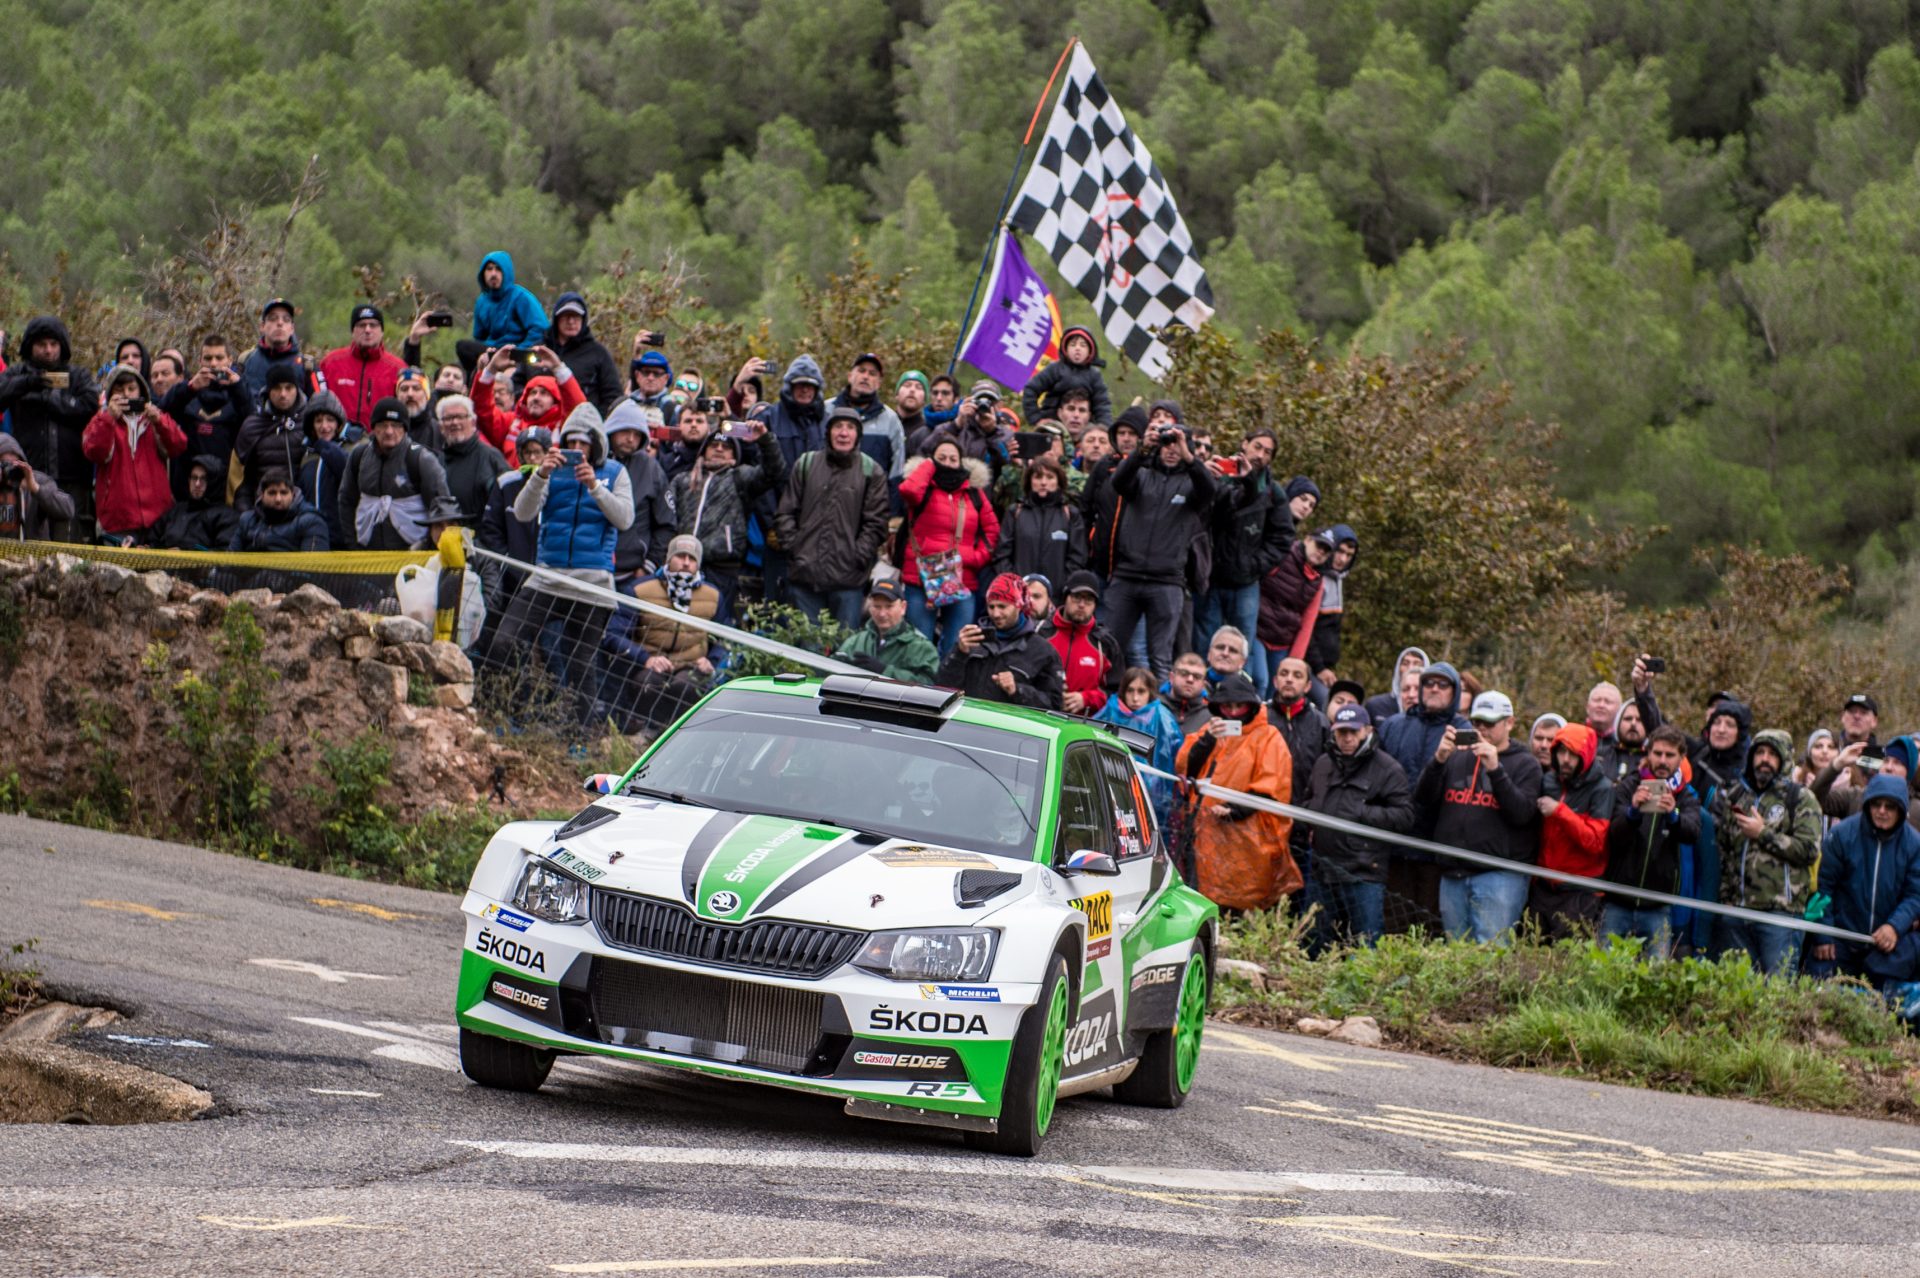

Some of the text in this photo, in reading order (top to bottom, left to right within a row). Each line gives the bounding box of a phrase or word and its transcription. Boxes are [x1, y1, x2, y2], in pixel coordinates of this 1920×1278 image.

[572, 861, 601, 879] 0390
[723, 848, 774, 883] ŠKODA
[1086, 894, 1110, 937] RACC
[476, 927, 545, 973] ŠKODA
[1143, 966, 1177, 985] EDGE
[513, 988, 549, 1010] EDGE
[948, 989, 999, 997] MICHELIN
[869, 1003, 989, 1035] ŠKODA
[1063, 1011, 1111, 1068] KODA
[864, 1053, 951, 1069] Castrol EDGE
[906, 1082, 970, 1097] R5
